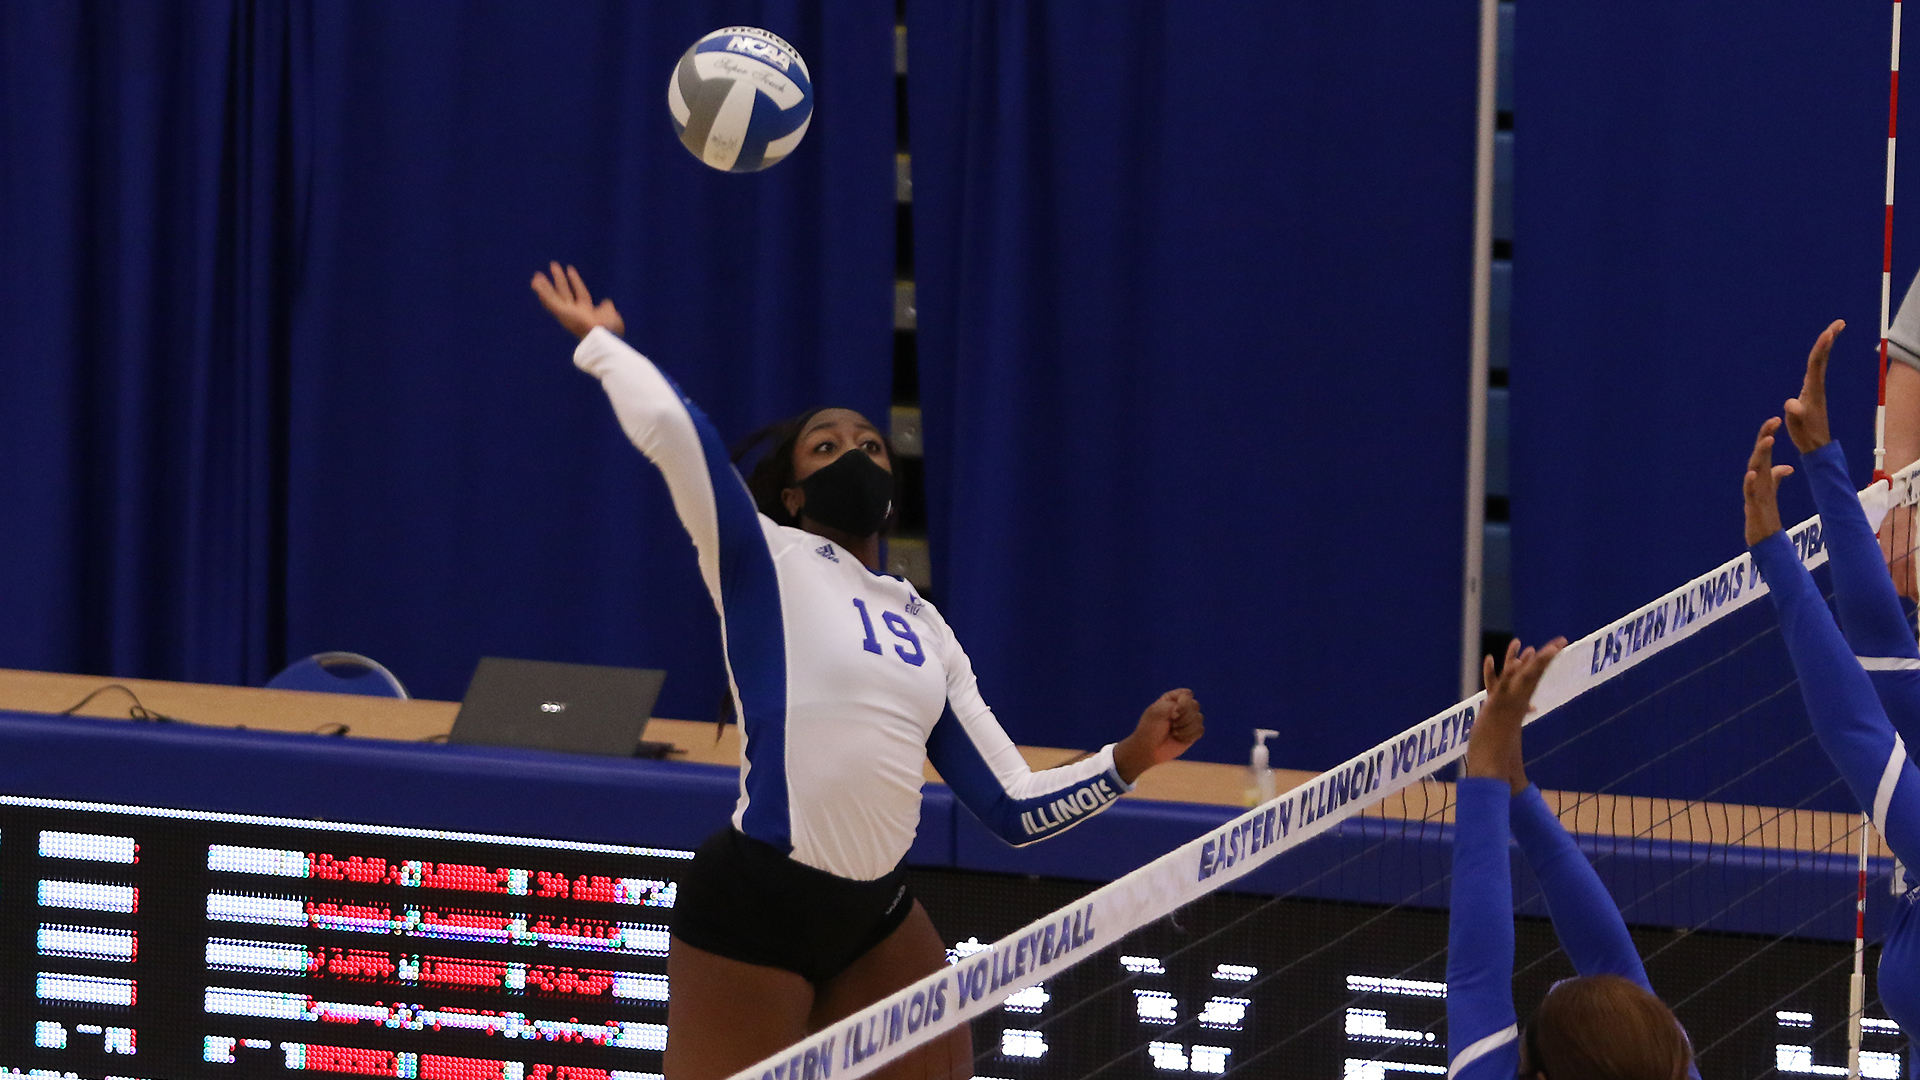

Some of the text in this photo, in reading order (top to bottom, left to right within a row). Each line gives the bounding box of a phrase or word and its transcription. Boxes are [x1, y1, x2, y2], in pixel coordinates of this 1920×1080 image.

[725, 36, 791, 73] NCAA
[852, 597, 926, 667] 19
[905, 603, 920, 615] EIU
[1590, 562, 1746, 676] EASTERN ILLINOIS
[1021, 778, 1117, 835] ILLINOIS
[1197, 699, 1485, 882] EASTERN ILLINOIS VOLLEYB
[843, 976, 949, 1069] ILLINOIS
[957, 903, 1095, 1009] VOLLEYBALL
